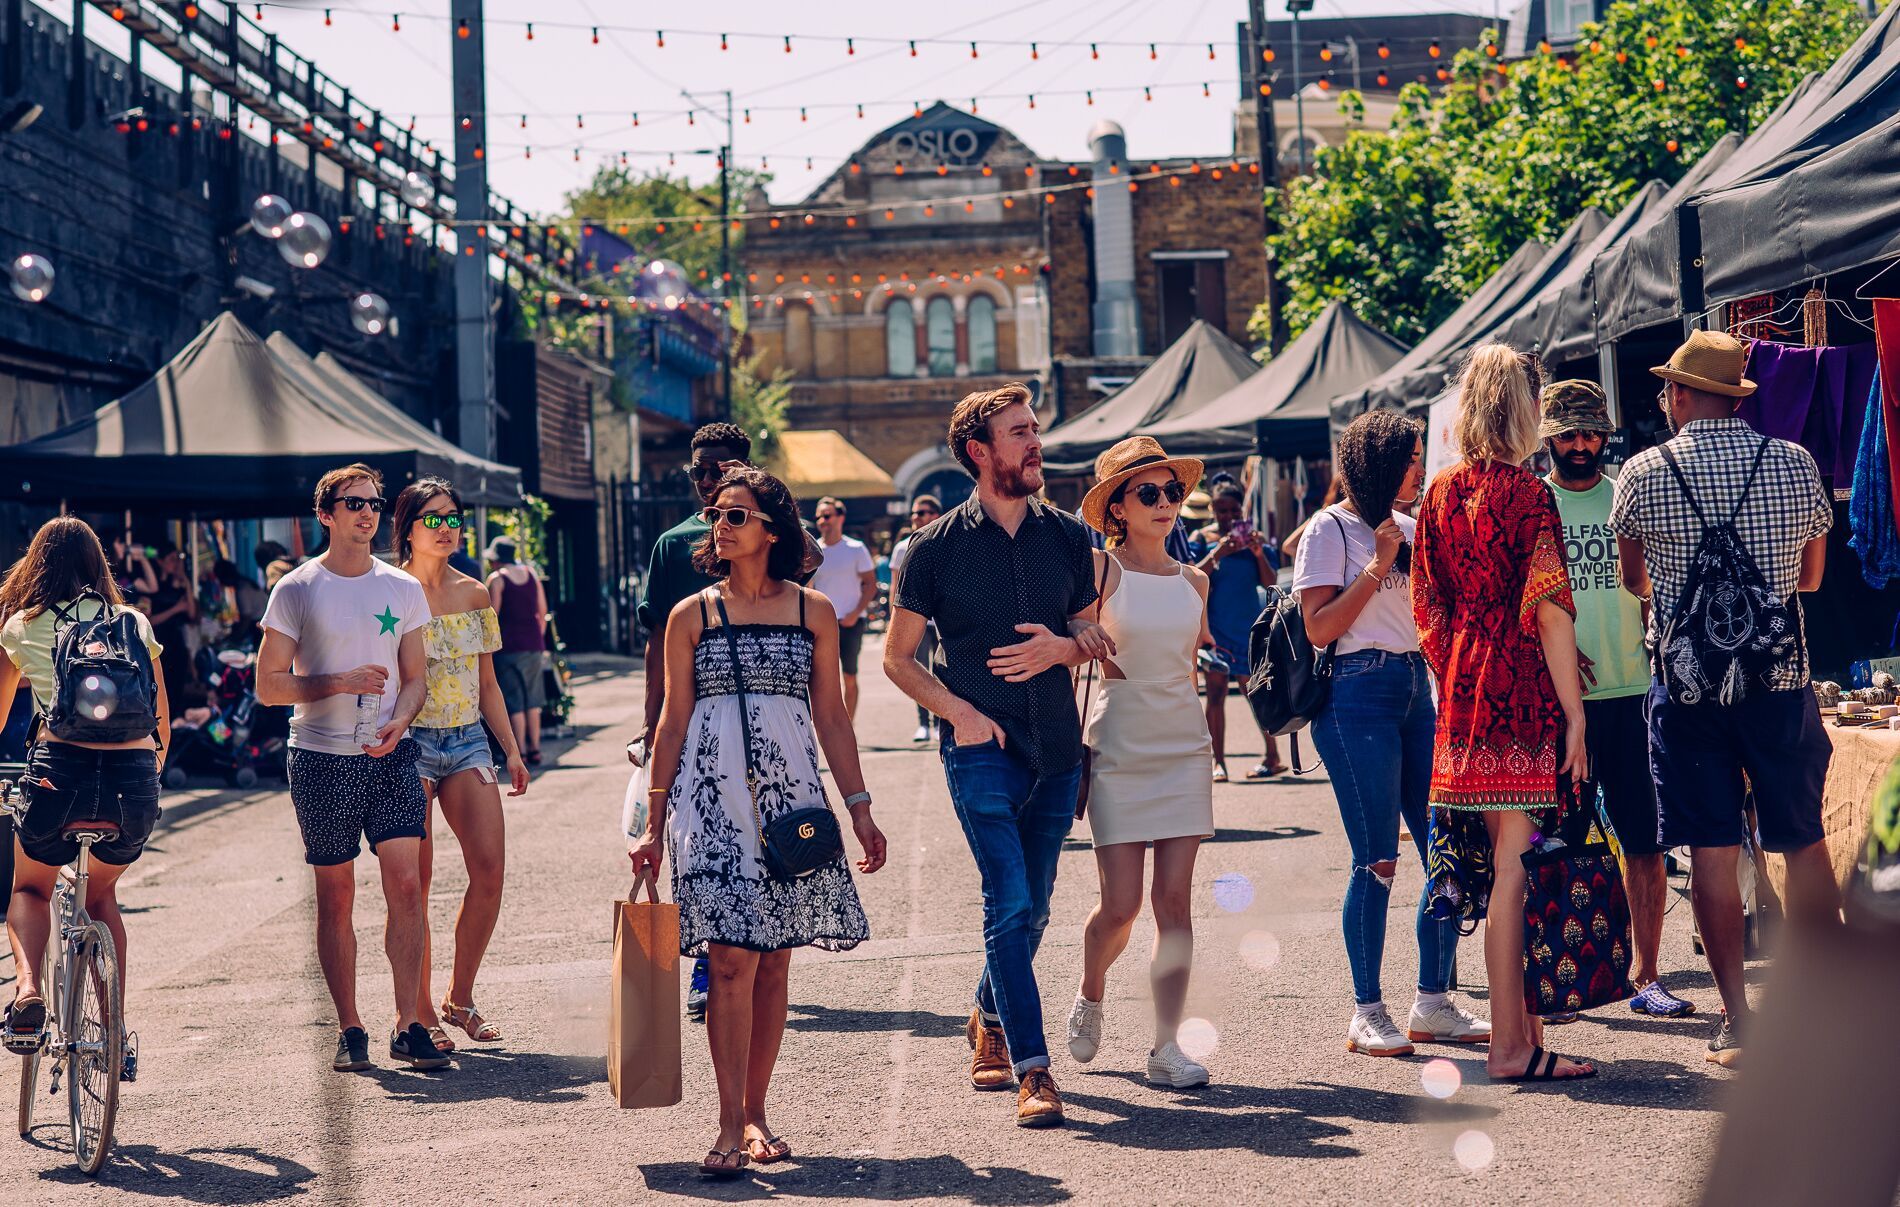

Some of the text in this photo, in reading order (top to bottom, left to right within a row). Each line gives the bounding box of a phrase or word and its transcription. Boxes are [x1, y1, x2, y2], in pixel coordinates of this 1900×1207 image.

[889, 128, 979, 159] OSLO
[1568, 561, 1619, 577] TWOR
[1381, 575, 1411, 590] OYA
